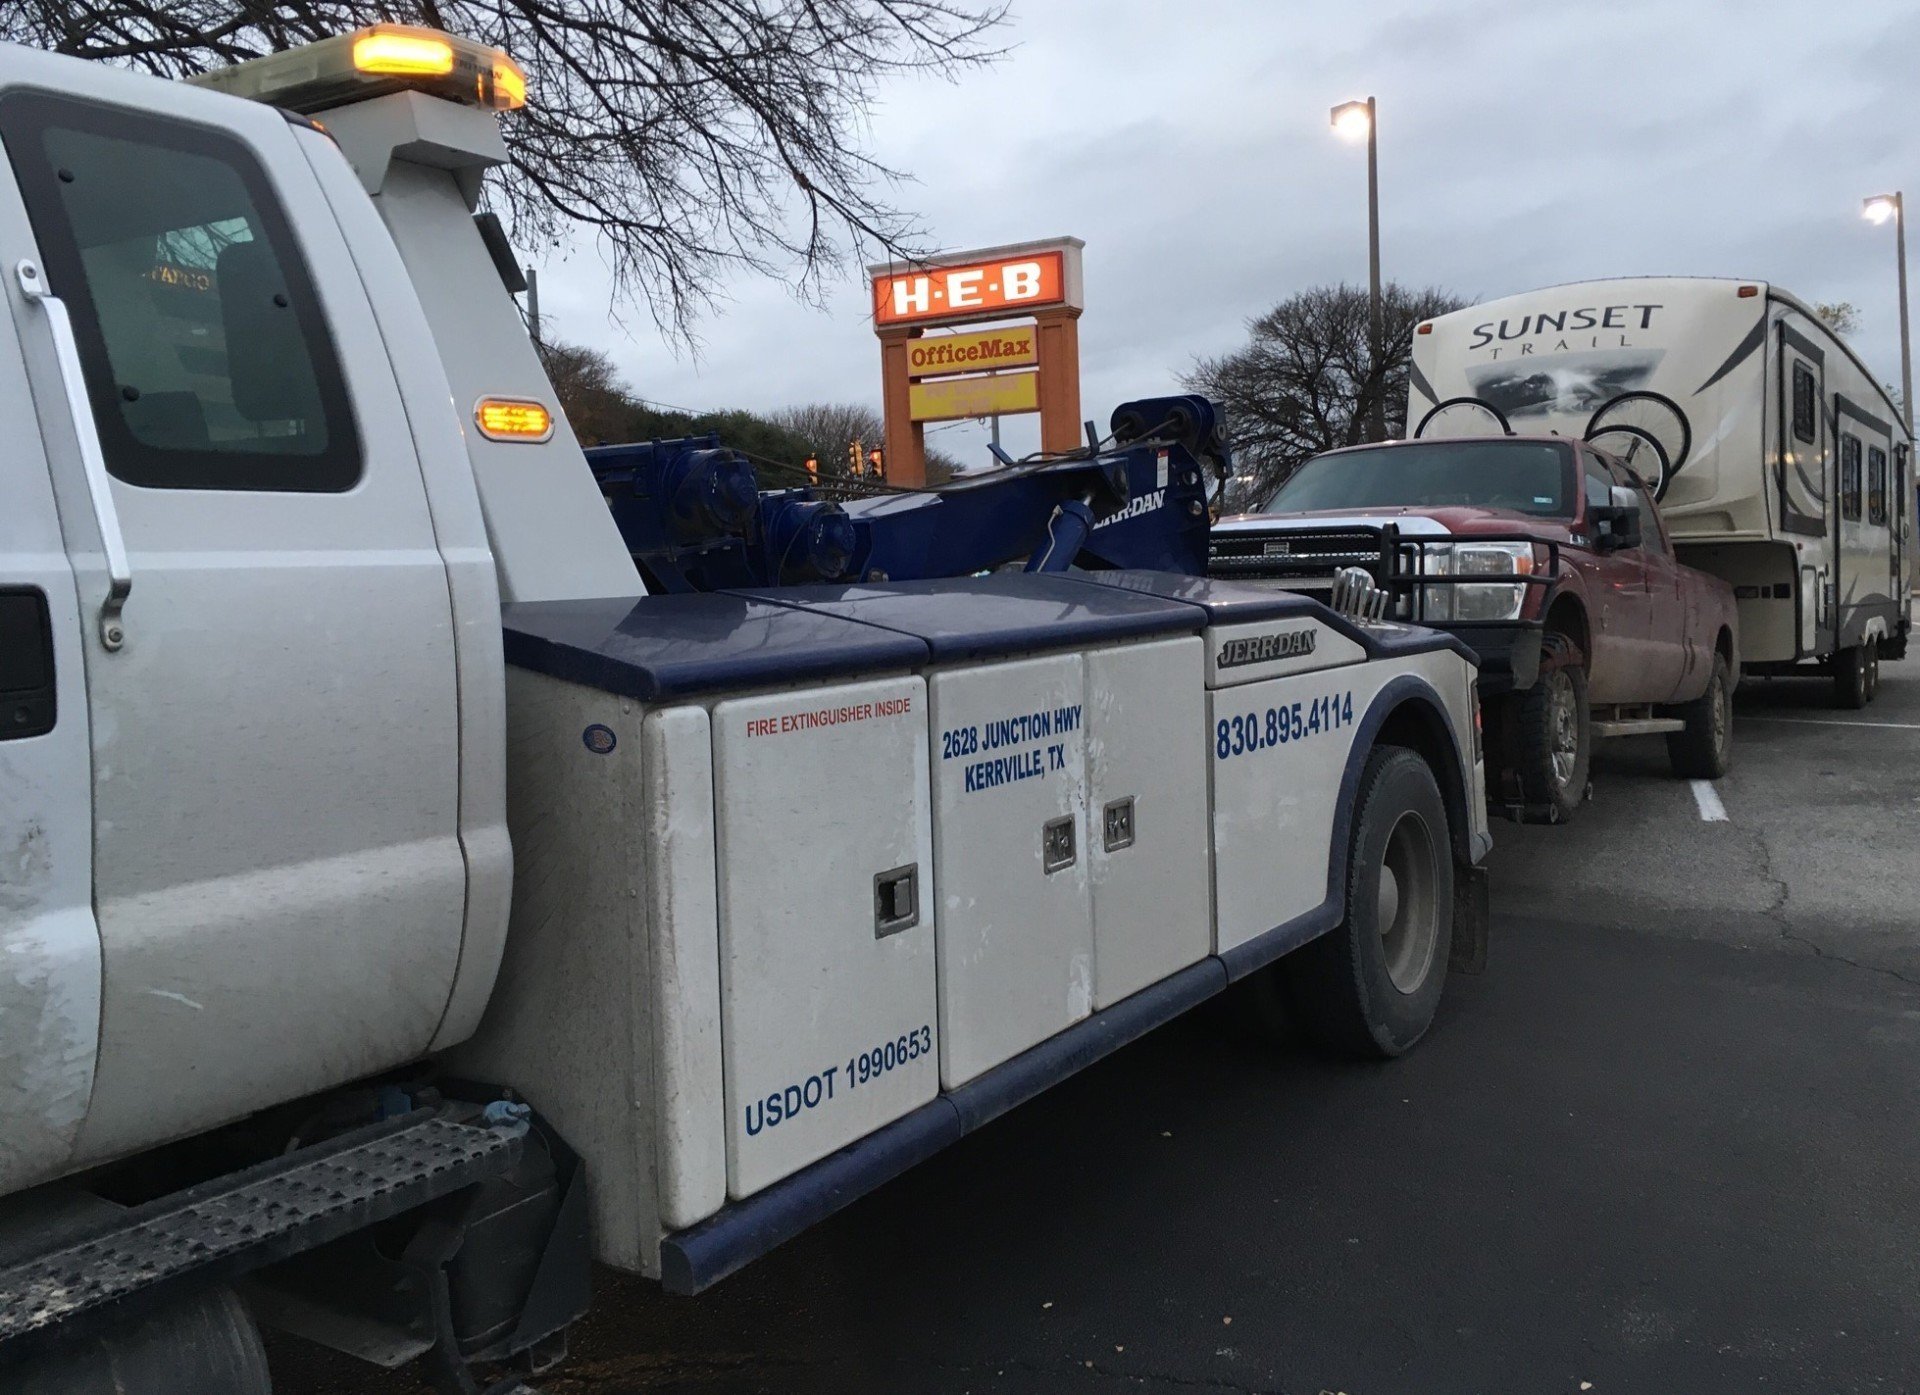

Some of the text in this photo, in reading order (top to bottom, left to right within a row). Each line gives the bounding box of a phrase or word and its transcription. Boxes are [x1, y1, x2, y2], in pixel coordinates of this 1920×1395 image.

[1470, 305, 1663, 349] SUNSET
[1492, 335, 1632, 359] TRAIL
[911, 338, 1030, 367] OfficeMax
[747, 698, 911, 738] FIRE EXTINGUISHER INSIDE
[943, 704, 1082, 760] 2628 JUNCTION HWY
[1217, 691, 1353, 760] 830.895.4114
[965, 743, 1065, 793] KERRVILLE, TX
[745, 1025, 932, 1136] USDOT 1990653
